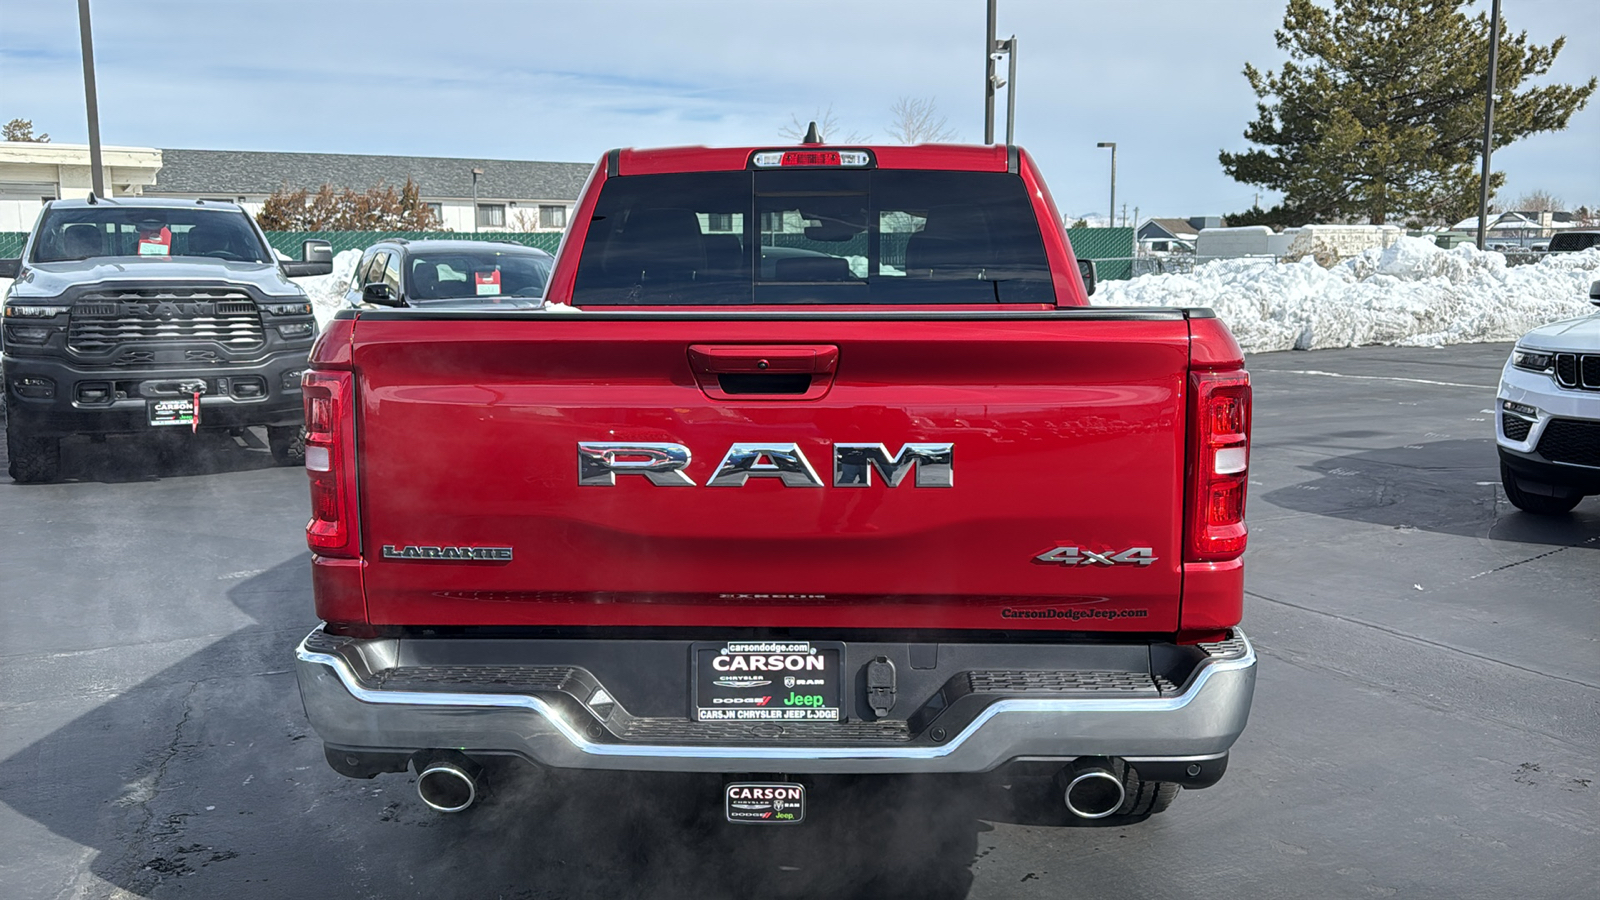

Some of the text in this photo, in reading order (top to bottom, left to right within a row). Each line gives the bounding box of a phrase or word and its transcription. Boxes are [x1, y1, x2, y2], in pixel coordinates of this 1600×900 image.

[154, 403, 194, 411] CARSON
[577, 441, 955, 488] RAM
[382, 544, 513, 561] LARAMIE
[1035, 546, 1160, 566] 4x4
[1001, 608, 1148, 621] CarsonDodgeJeep.com
[729, 642, 808, 653] carsondodge.com
[712, 655, 825, 671] CARSON
[783, 692, 824, 708] Jeep
[737, 710, 782, 719] CHRYSLER
[783, 710, 806, 719] JEEP
[729, 788, 800, 799] CARSON
